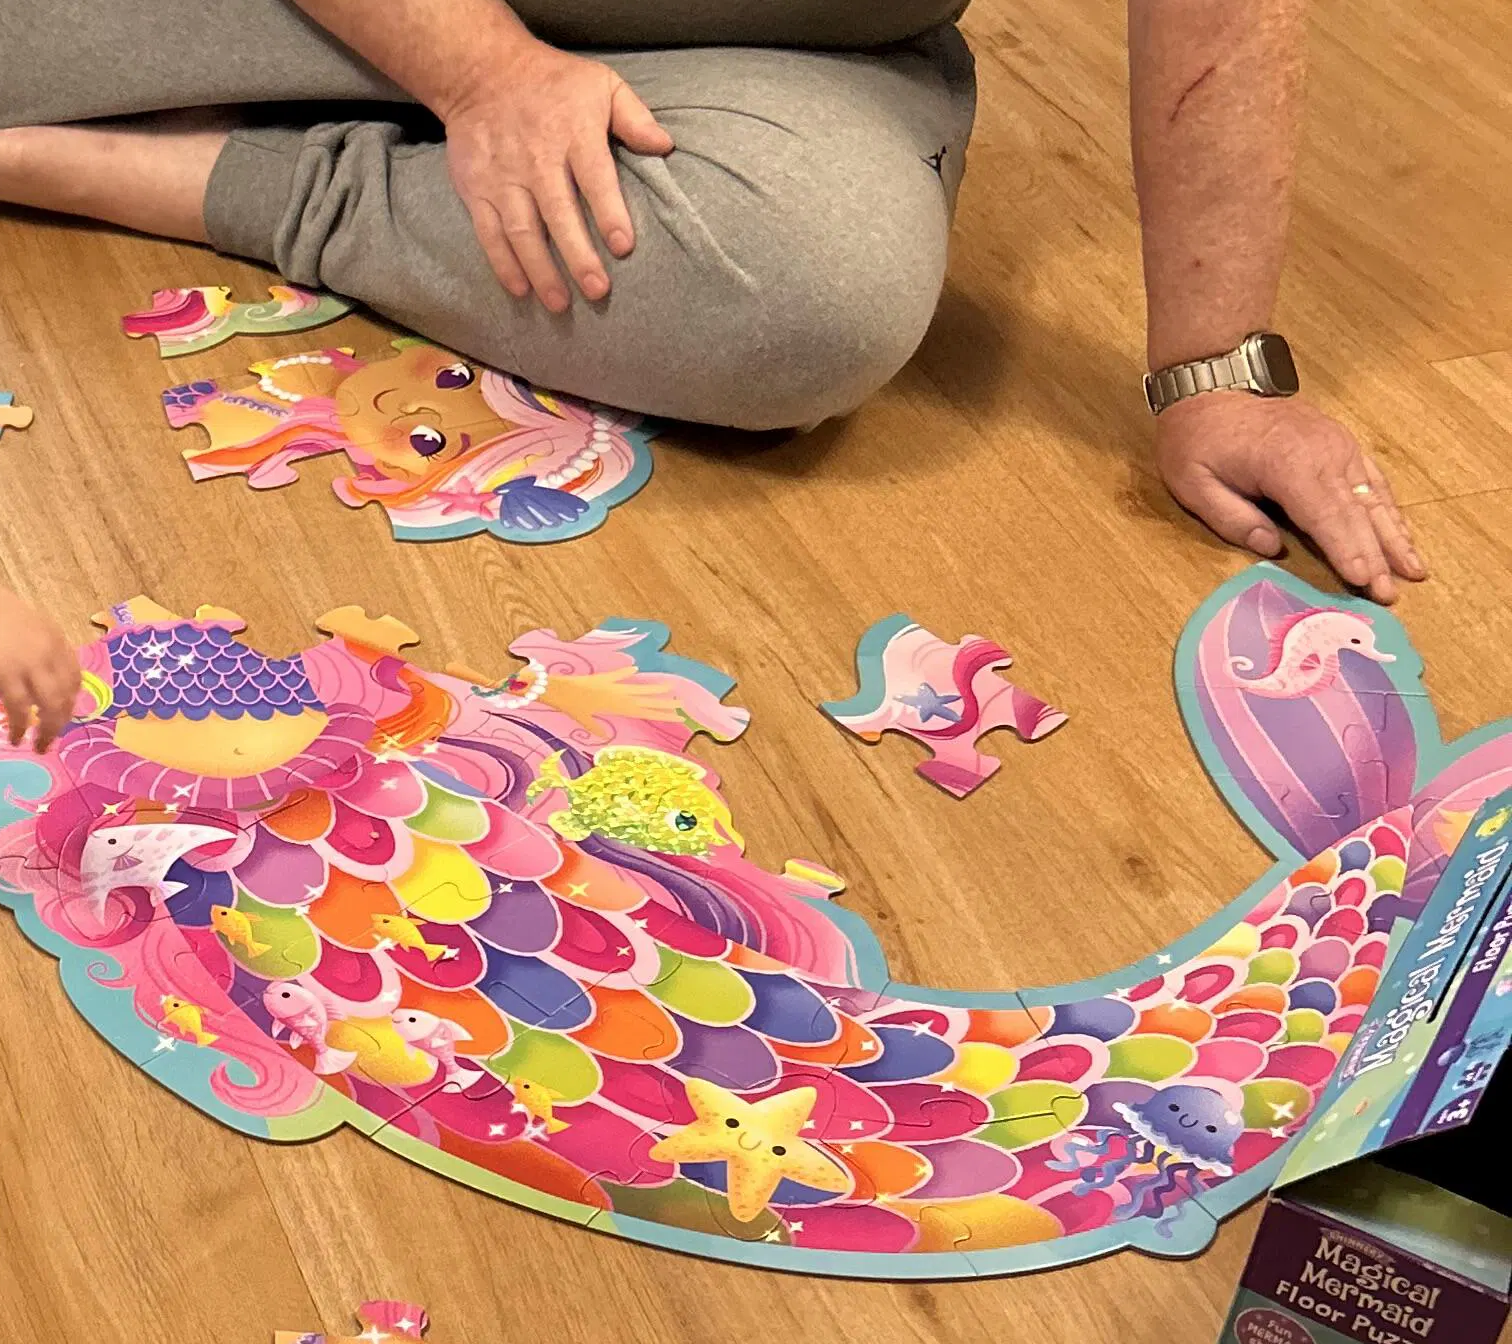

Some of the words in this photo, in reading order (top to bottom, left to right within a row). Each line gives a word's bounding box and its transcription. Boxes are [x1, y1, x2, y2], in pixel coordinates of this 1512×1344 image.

[1354, 957, 1446, 1077] Magical
[1417, 841, 1510, 961] Mermaid
[1471, 931, 1510, 973] Floor
[1275, 1280, 1346, 1322] Floor
[1300, 1260, 1435, 1338] Mermaid
[1315, 1236, 1442, 1309] Magical
[1267, 1319, 1293, 1339] Fun
